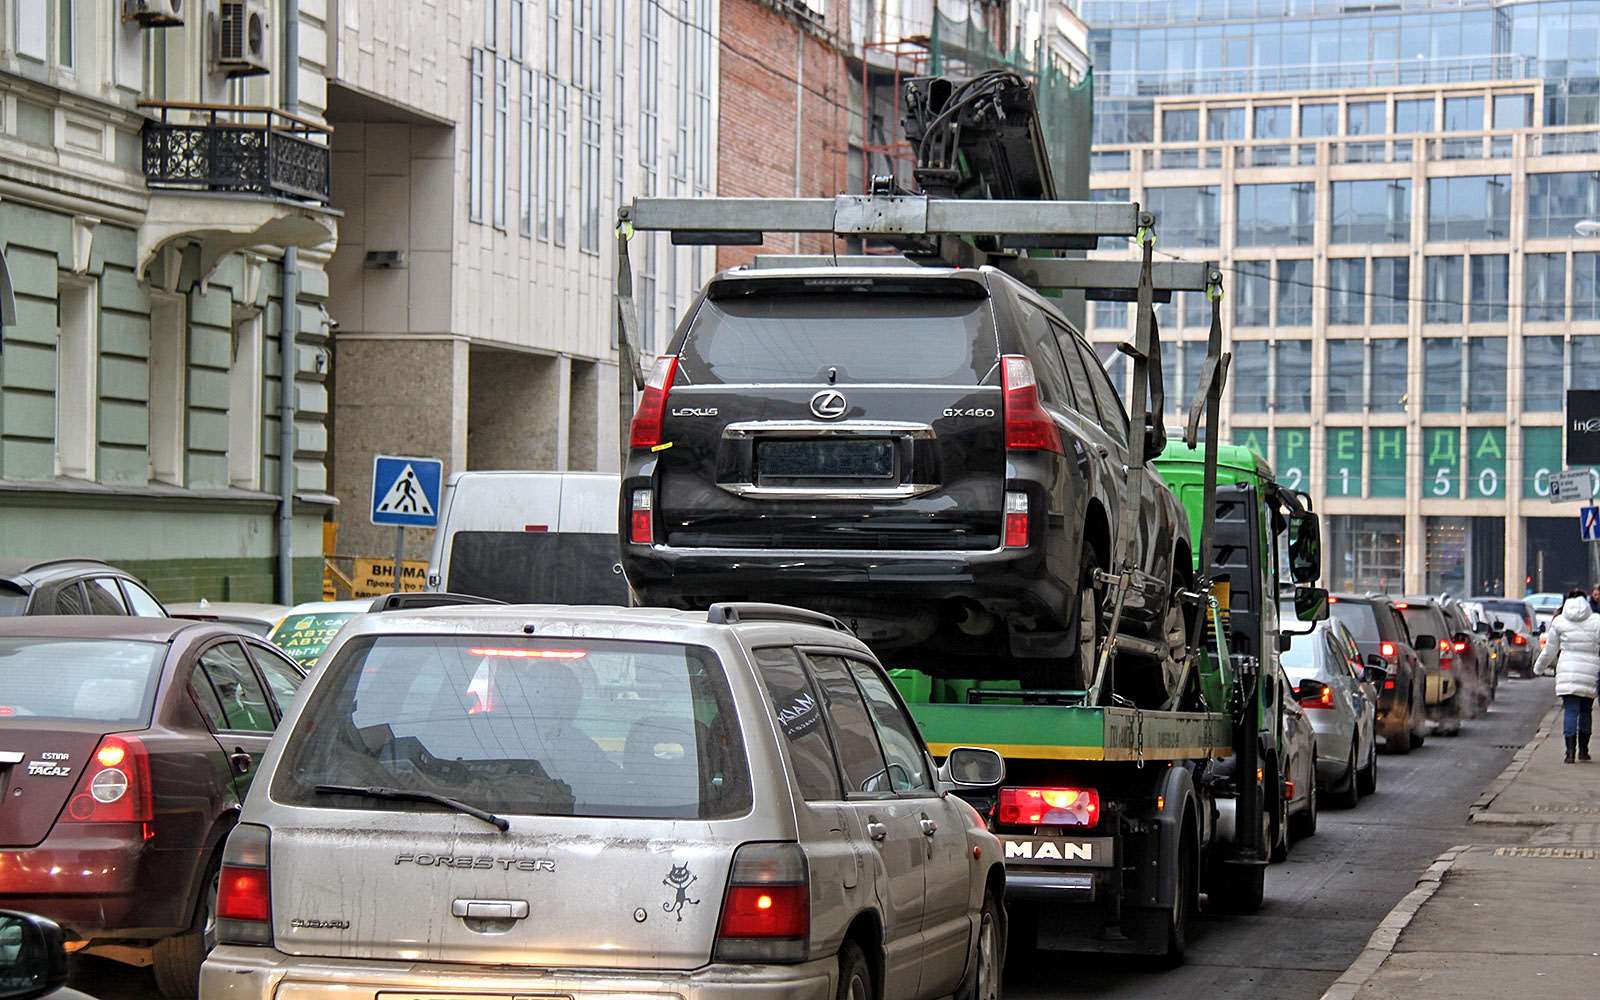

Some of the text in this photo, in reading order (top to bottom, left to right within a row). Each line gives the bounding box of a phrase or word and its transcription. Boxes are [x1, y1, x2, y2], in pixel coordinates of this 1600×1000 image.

[672, 407, 719, 417] LEXUS
[1244, 431, 1503, 466] АРЕНДА
[366, 579, 402, 588] Прохо
[42, 752, 70, 760] ESTINA
[28, 766, 71, 777] TAGAZ
[1005, 840, 1092, 860] MAN
[394, 853, 556, 872] FORESTER
[290, 918, 350, 930] SUBARU
